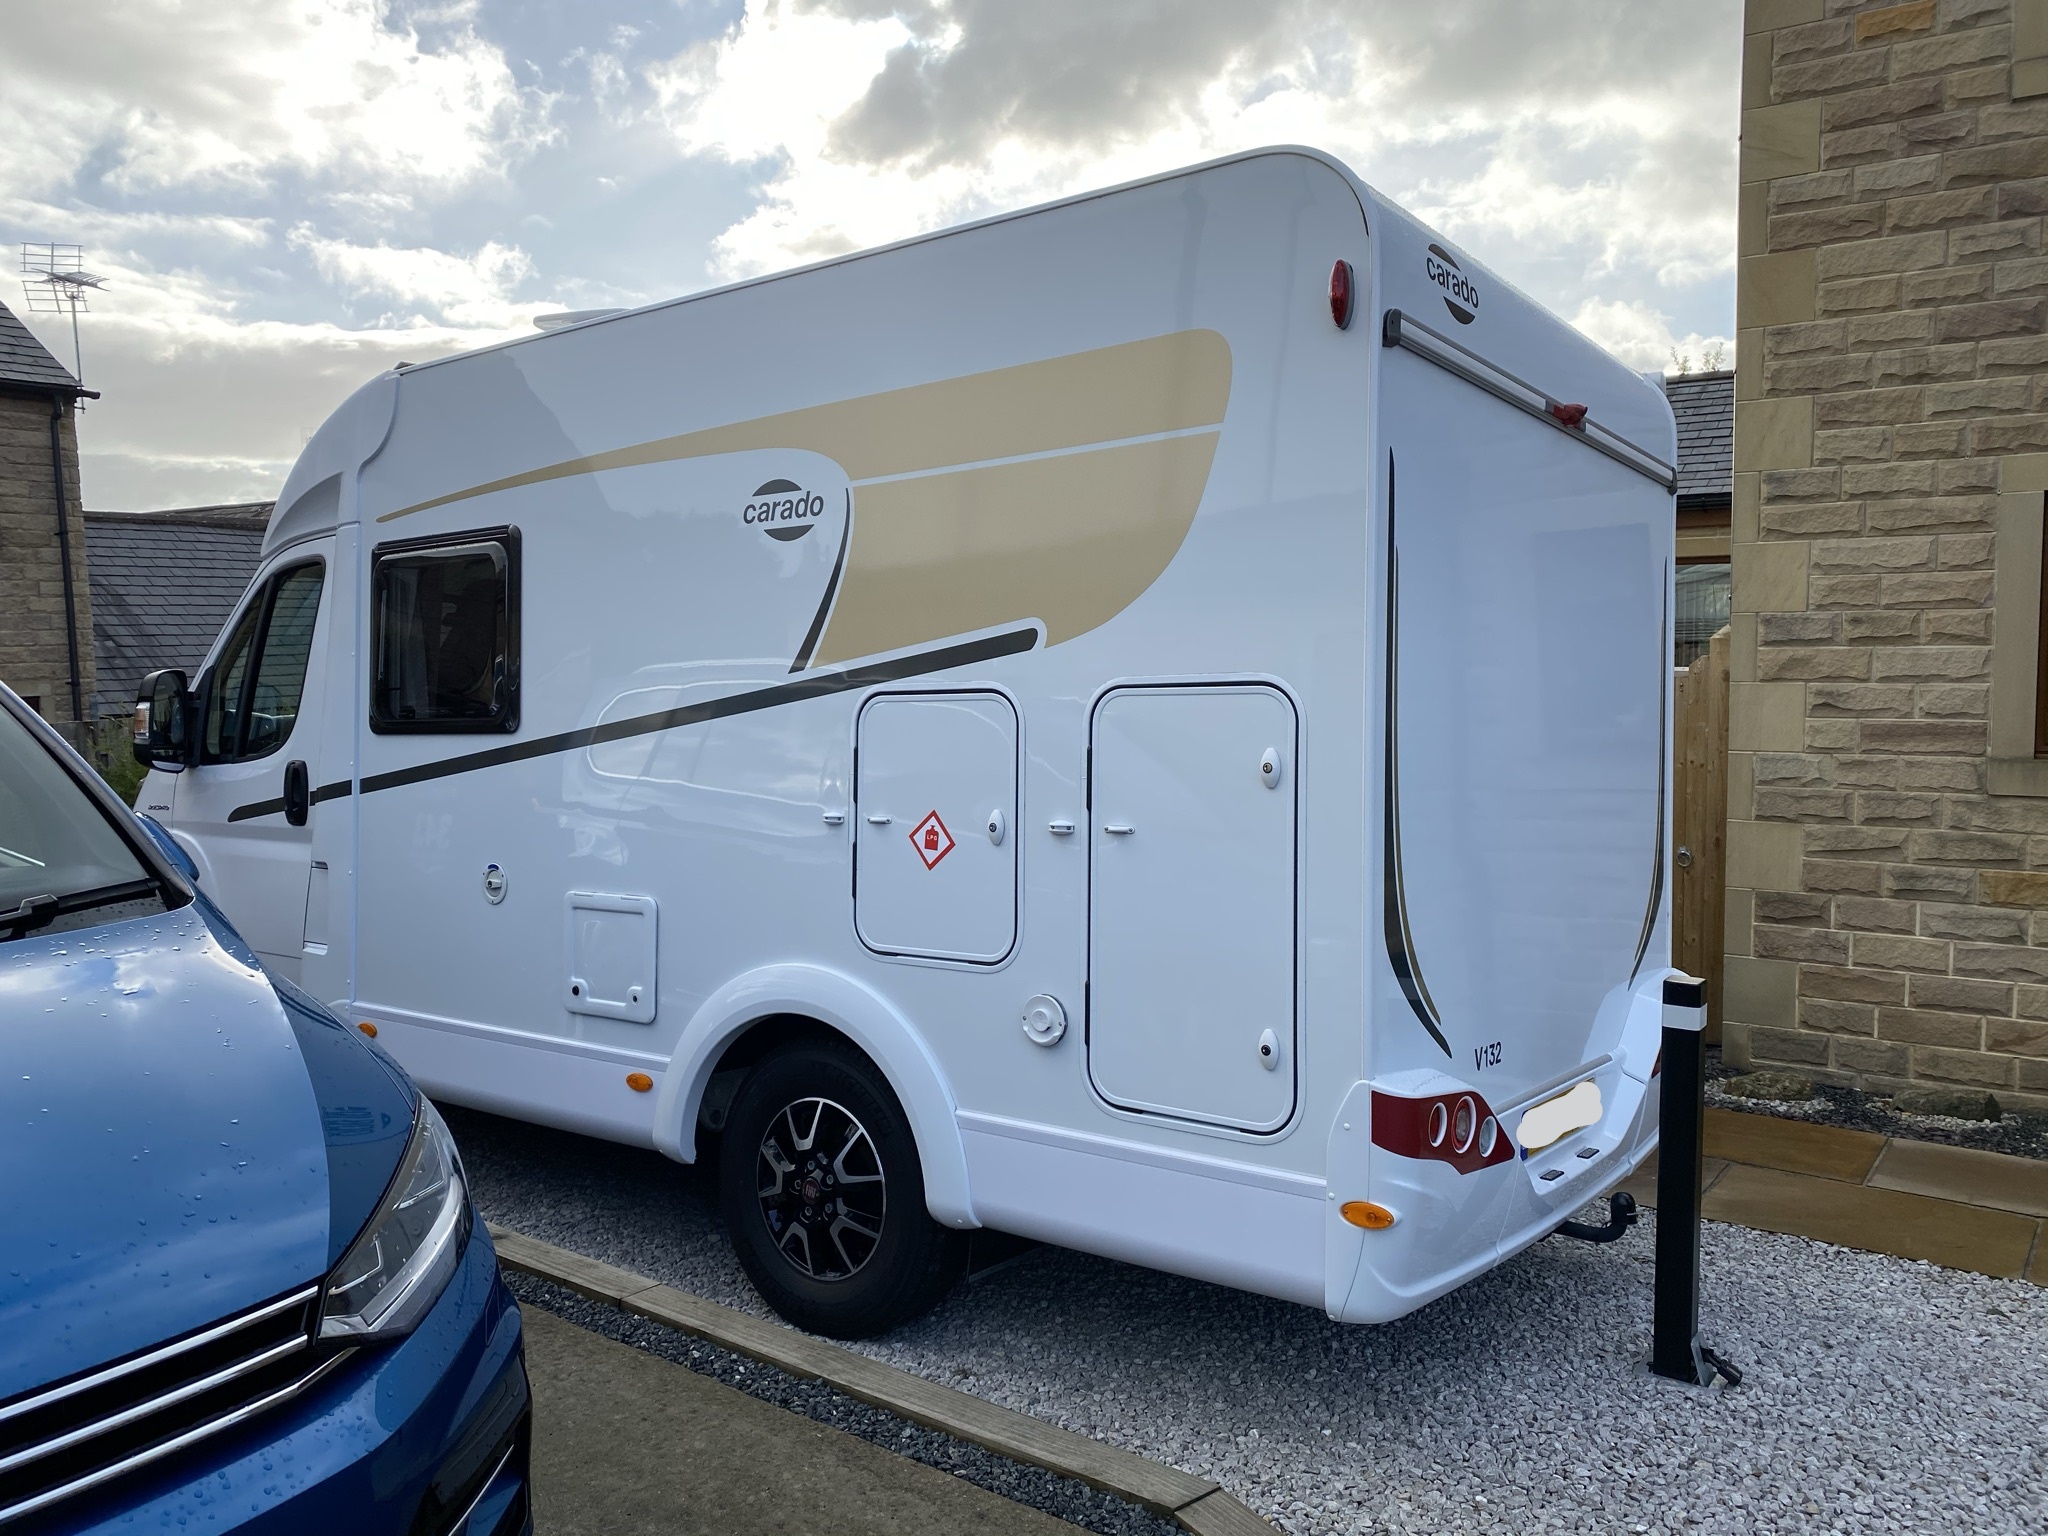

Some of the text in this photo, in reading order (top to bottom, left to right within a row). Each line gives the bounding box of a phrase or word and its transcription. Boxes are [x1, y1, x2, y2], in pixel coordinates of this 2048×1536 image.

[1426, 256, 1479, 309] carado
[743, 490, 824, 525] carado
[1474, 1041, 1502, 1071] V132
[805, 1183, 817, 1200] FIAT
